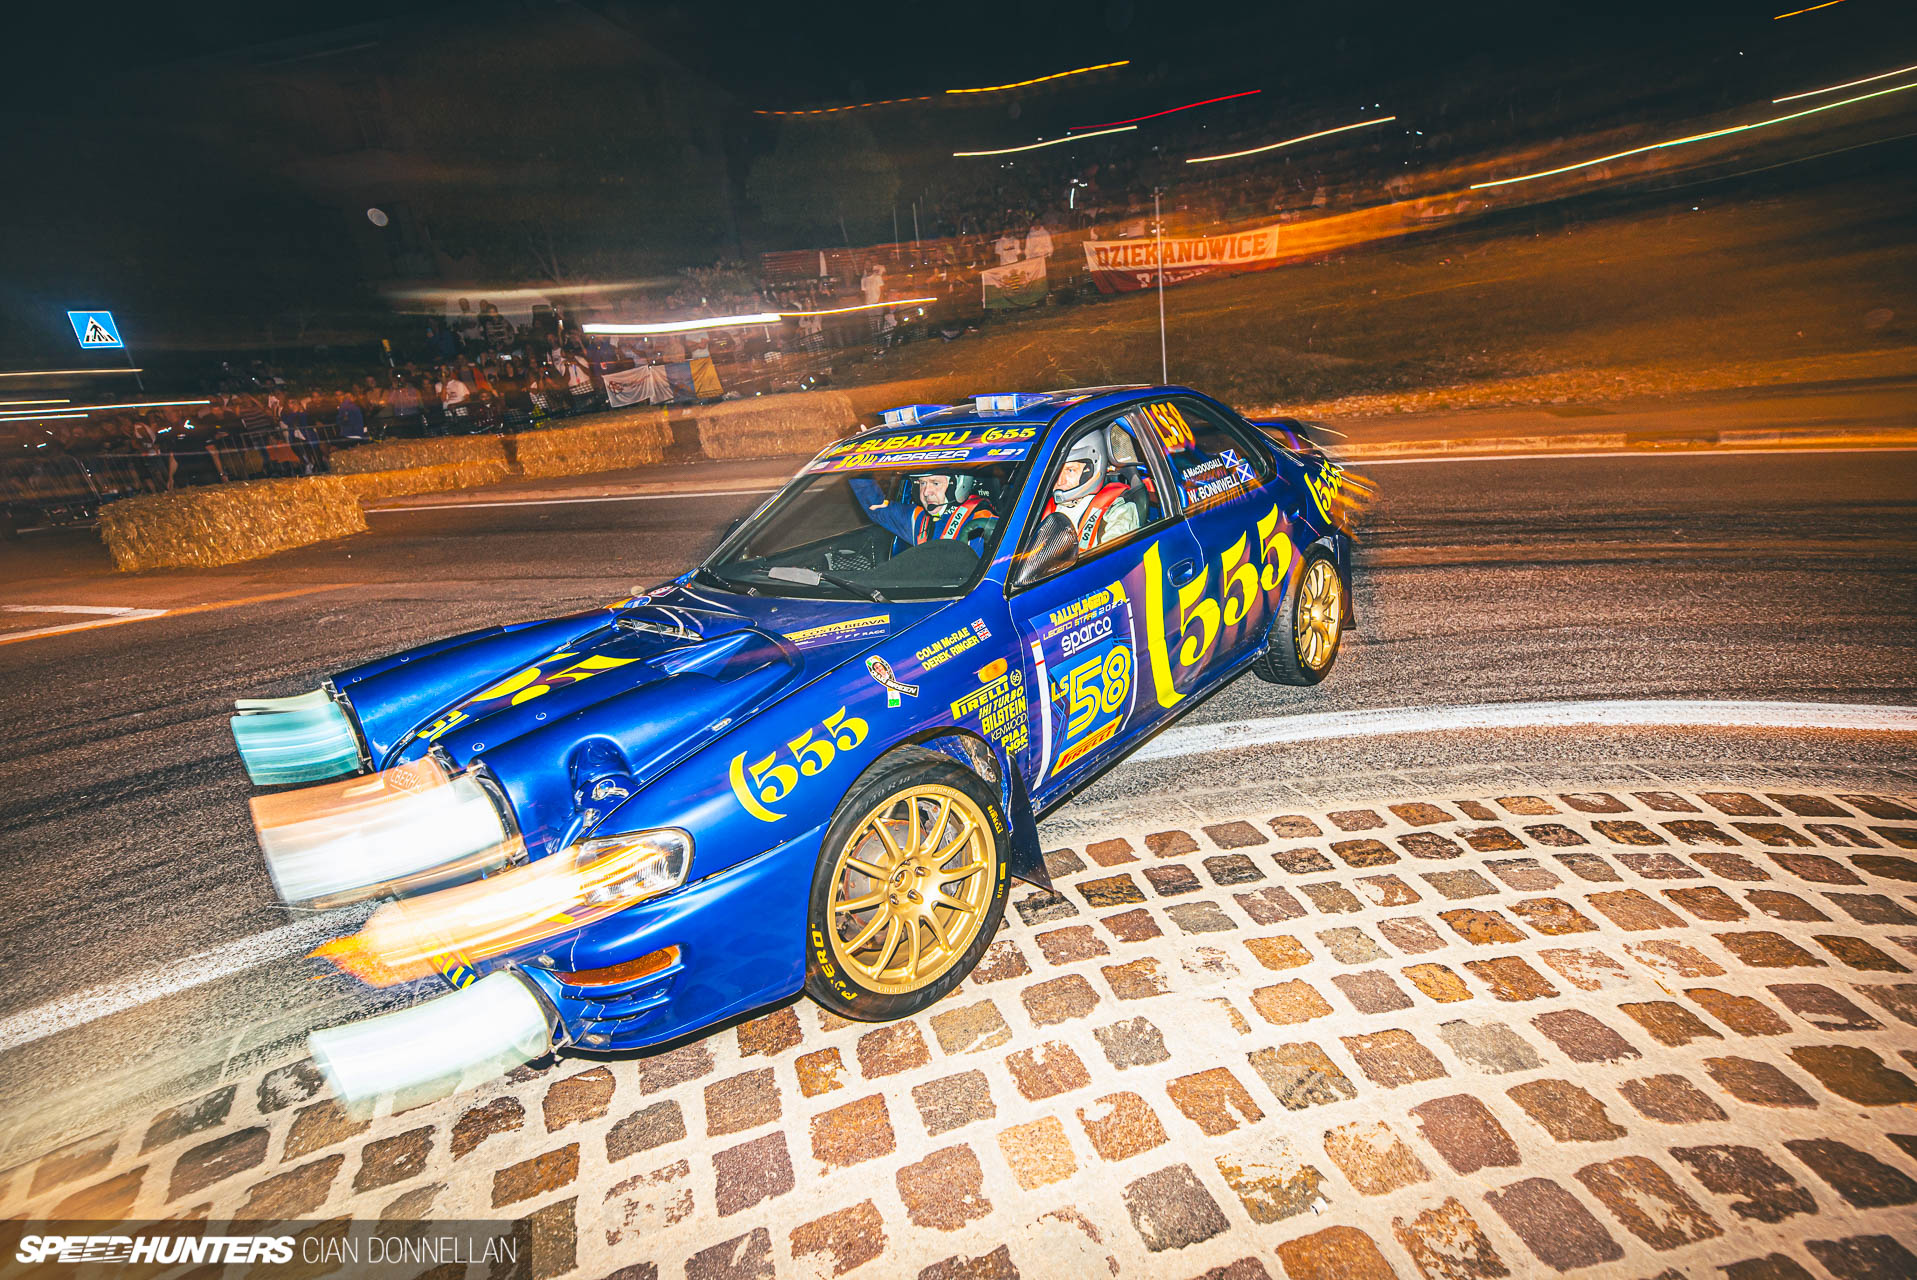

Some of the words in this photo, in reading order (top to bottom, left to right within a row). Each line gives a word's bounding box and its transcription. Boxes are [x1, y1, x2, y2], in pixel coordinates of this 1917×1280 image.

[1094, 232, 1268, 267] DZIEKANOWICE
[855, 430, 972, 453] SUBARU
[878, 449, 970, 464] IMPREZA
[1198, 473, 1240, 500] BONNIWELL
[844, 619, 885, 629] BRAVA
[1043, 620, 1073, 641] LEGEND
[1098, 600, 1124, 615] 2023
[1061, 616, 1112, 656] sparco
[915, 641, 944, 661] COLIN
[940, 626, 971, 648] McRAE
[921, 649, 953, 672] DEREK
[949, 635, 980, 656] RINGER
[950, 675, 1010, 720] PIRELLI
[993, 686, 1024, 711] TURBO
[1067, 645, 1132, 740] 58
[981, 696, 1027, 735] BILSTEIN
[991, 713, 1027, 742] KENWOOD
[1001, 724, 1028, 747] PIAA
[1006, 733, 1028, 756] NGK
[1057, 722, 1116, 769] PIRELLI
